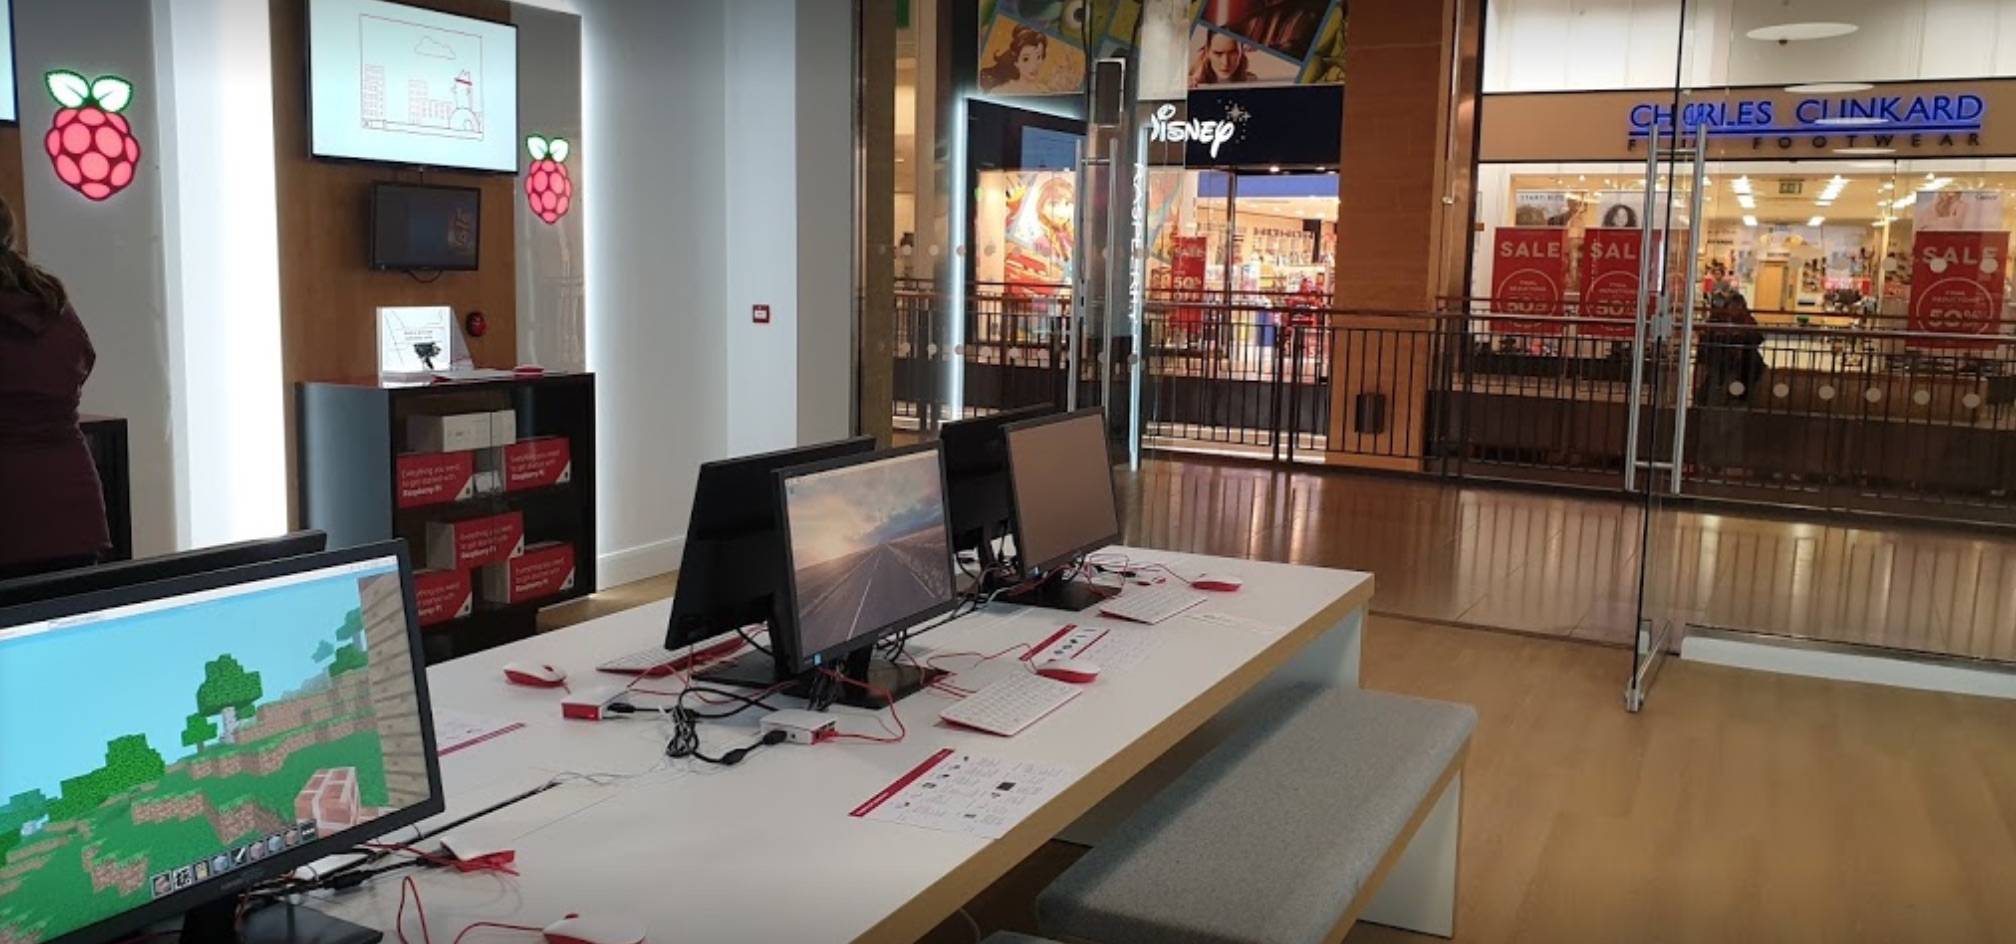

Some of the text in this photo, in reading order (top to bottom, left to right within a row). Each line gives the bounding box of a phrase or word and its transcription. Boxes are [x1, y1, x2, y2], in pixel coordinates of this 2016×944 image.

[1796, 95, 1984, 125] CLINKARD
[1752, 134, 1981, 150] FOOTWEAR
[1501, 241, 1561, 259] SALE
[1590, 241, 1637, 260] SAL
[1922, 246, 1998, 266] SALE
